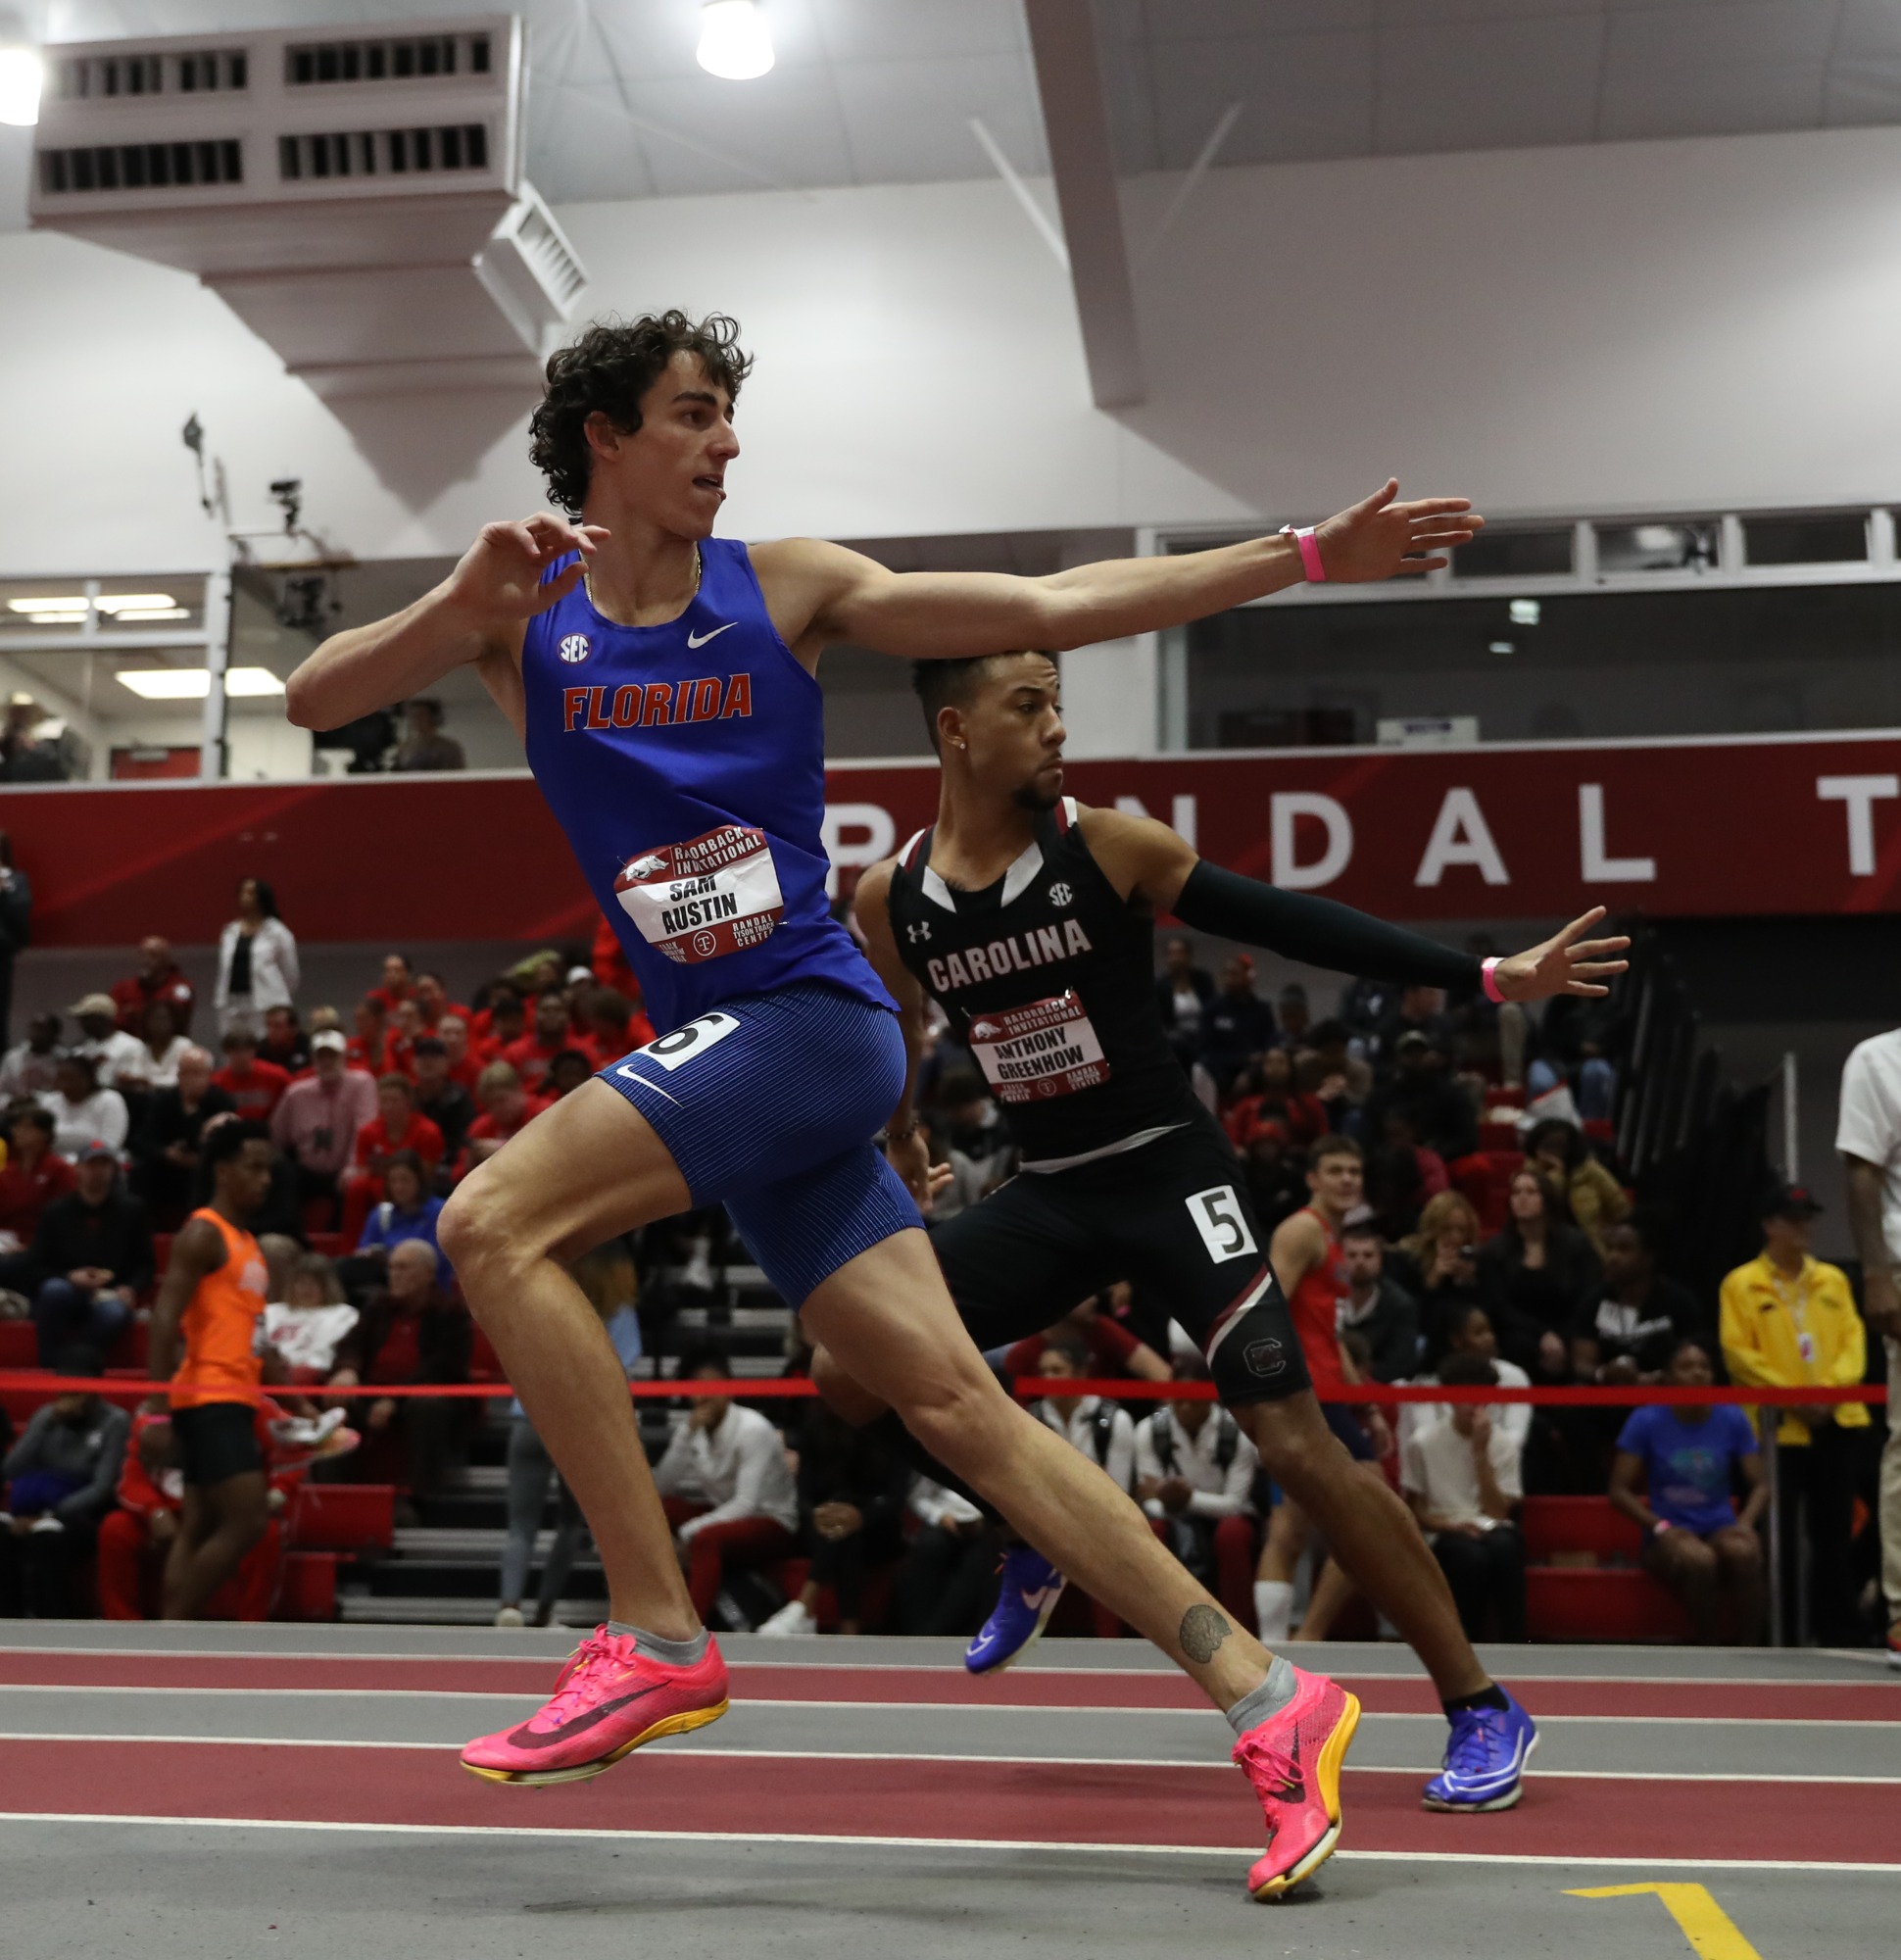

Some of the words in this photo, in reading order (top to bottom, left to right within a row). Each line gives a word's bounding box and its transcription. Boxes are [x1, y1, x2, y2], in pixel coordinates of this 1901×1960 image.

[560, 635, 589, 662] SEC
[562, 673, 752, 732] FLORIDA
[674, 826, 745, 860] RAORBACK
[822, 783, 1656, 900] RDAL
[669, 875, 717, 902] SAM
[1048, 882, 1073, 906] SEC
[661, 893, 738, 934] AUSTIN
[732, 913, 773, 932] RANDAL
[733, 928, 755, 940] TYSON
[927, 918, 1093, 992] CAROLINA
[1003, 998, 1067, 1026] RAZORBACK
[1008, 1005, 1081, 1036] INVITATIONAL
[648, 1014, 724, 1054] 6
[994, 1026, 1067, 1059] ANTHONY
[998, 1045, 1084, 1080] GREENHOW
[1201, 1191, 1244, 1253] 5
